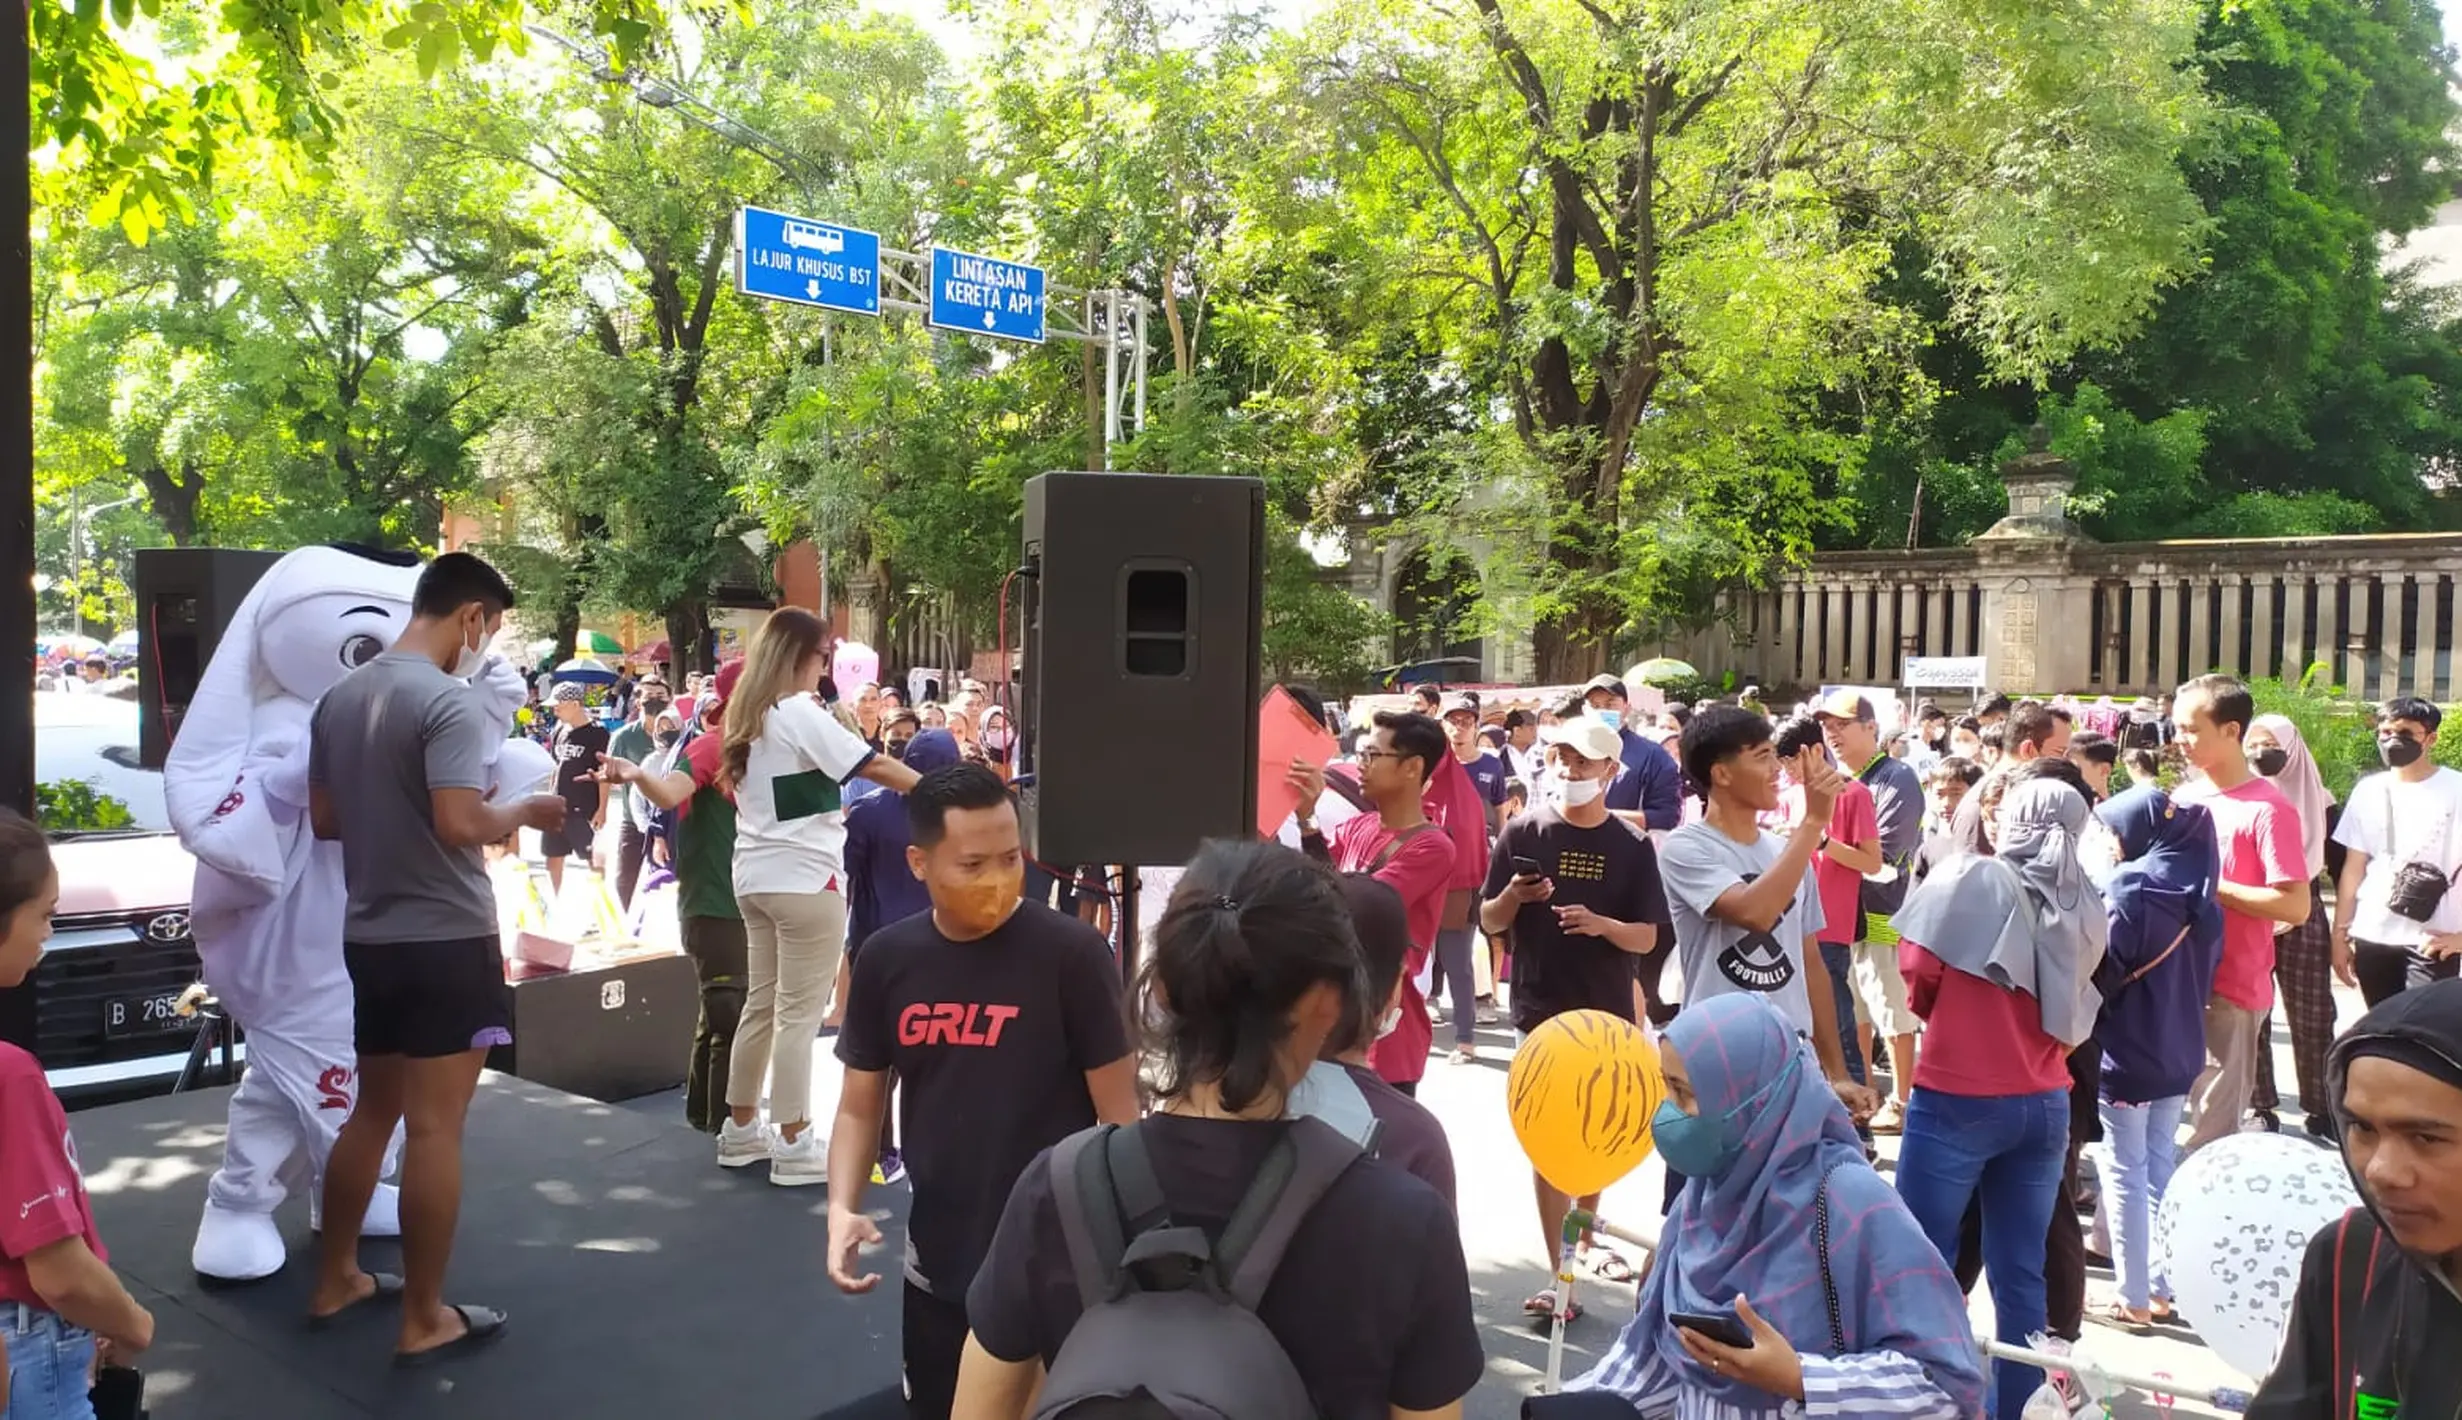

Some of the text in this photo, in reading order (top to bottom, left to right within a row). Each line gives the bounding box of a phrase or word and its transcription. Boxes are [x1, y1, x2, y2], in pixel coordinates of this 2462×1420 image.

[752, 247, 872, 288] LAJUR KHUSUS BST
[952, 255, 1027, 291] LINTASAN
[945, 278, 1033, 316] KERETA API
[112, 996, 180, 1025] B 265
[898, 1002, 1020, 1048] GRLT
